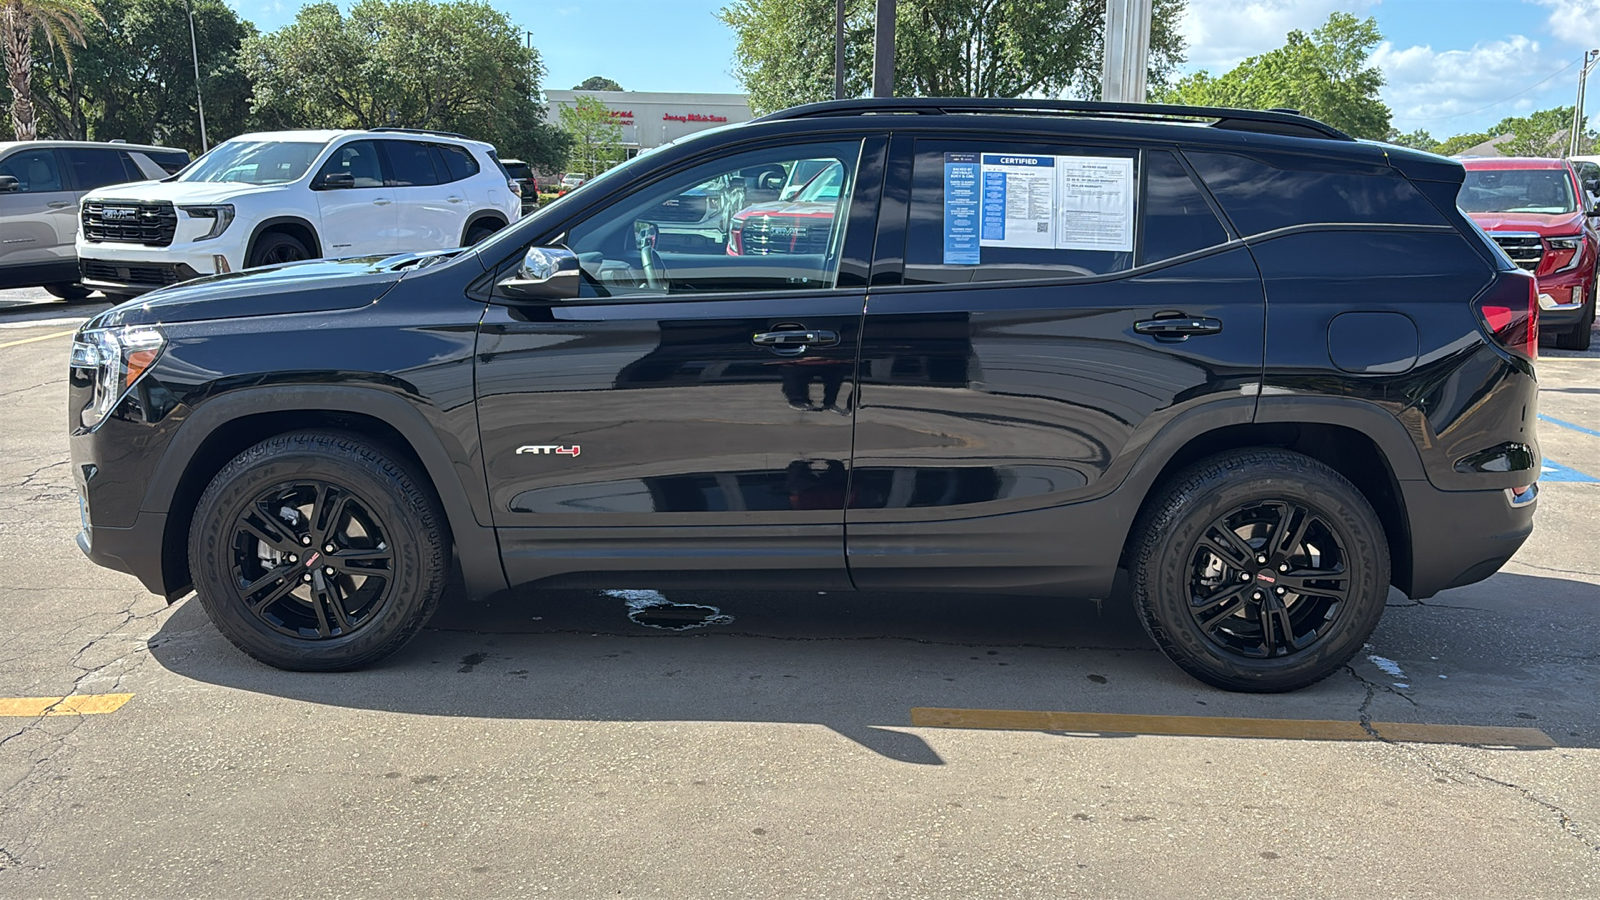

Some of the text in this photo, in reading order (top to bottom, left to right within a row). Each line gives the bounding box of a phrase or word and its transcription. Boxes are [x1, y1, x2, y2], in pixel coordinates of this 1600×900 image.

[1000, 157, 1038, 165] CERTIFIED
[102, 209, 136, 220] GMC
[515, 445, 581, 457] AT4
[205, 465, 277, 584] GOODYEAR
[1165, 521, 1206, 657] GOODYEAR
[1336, 504, 1371, 638] WRANGLER
